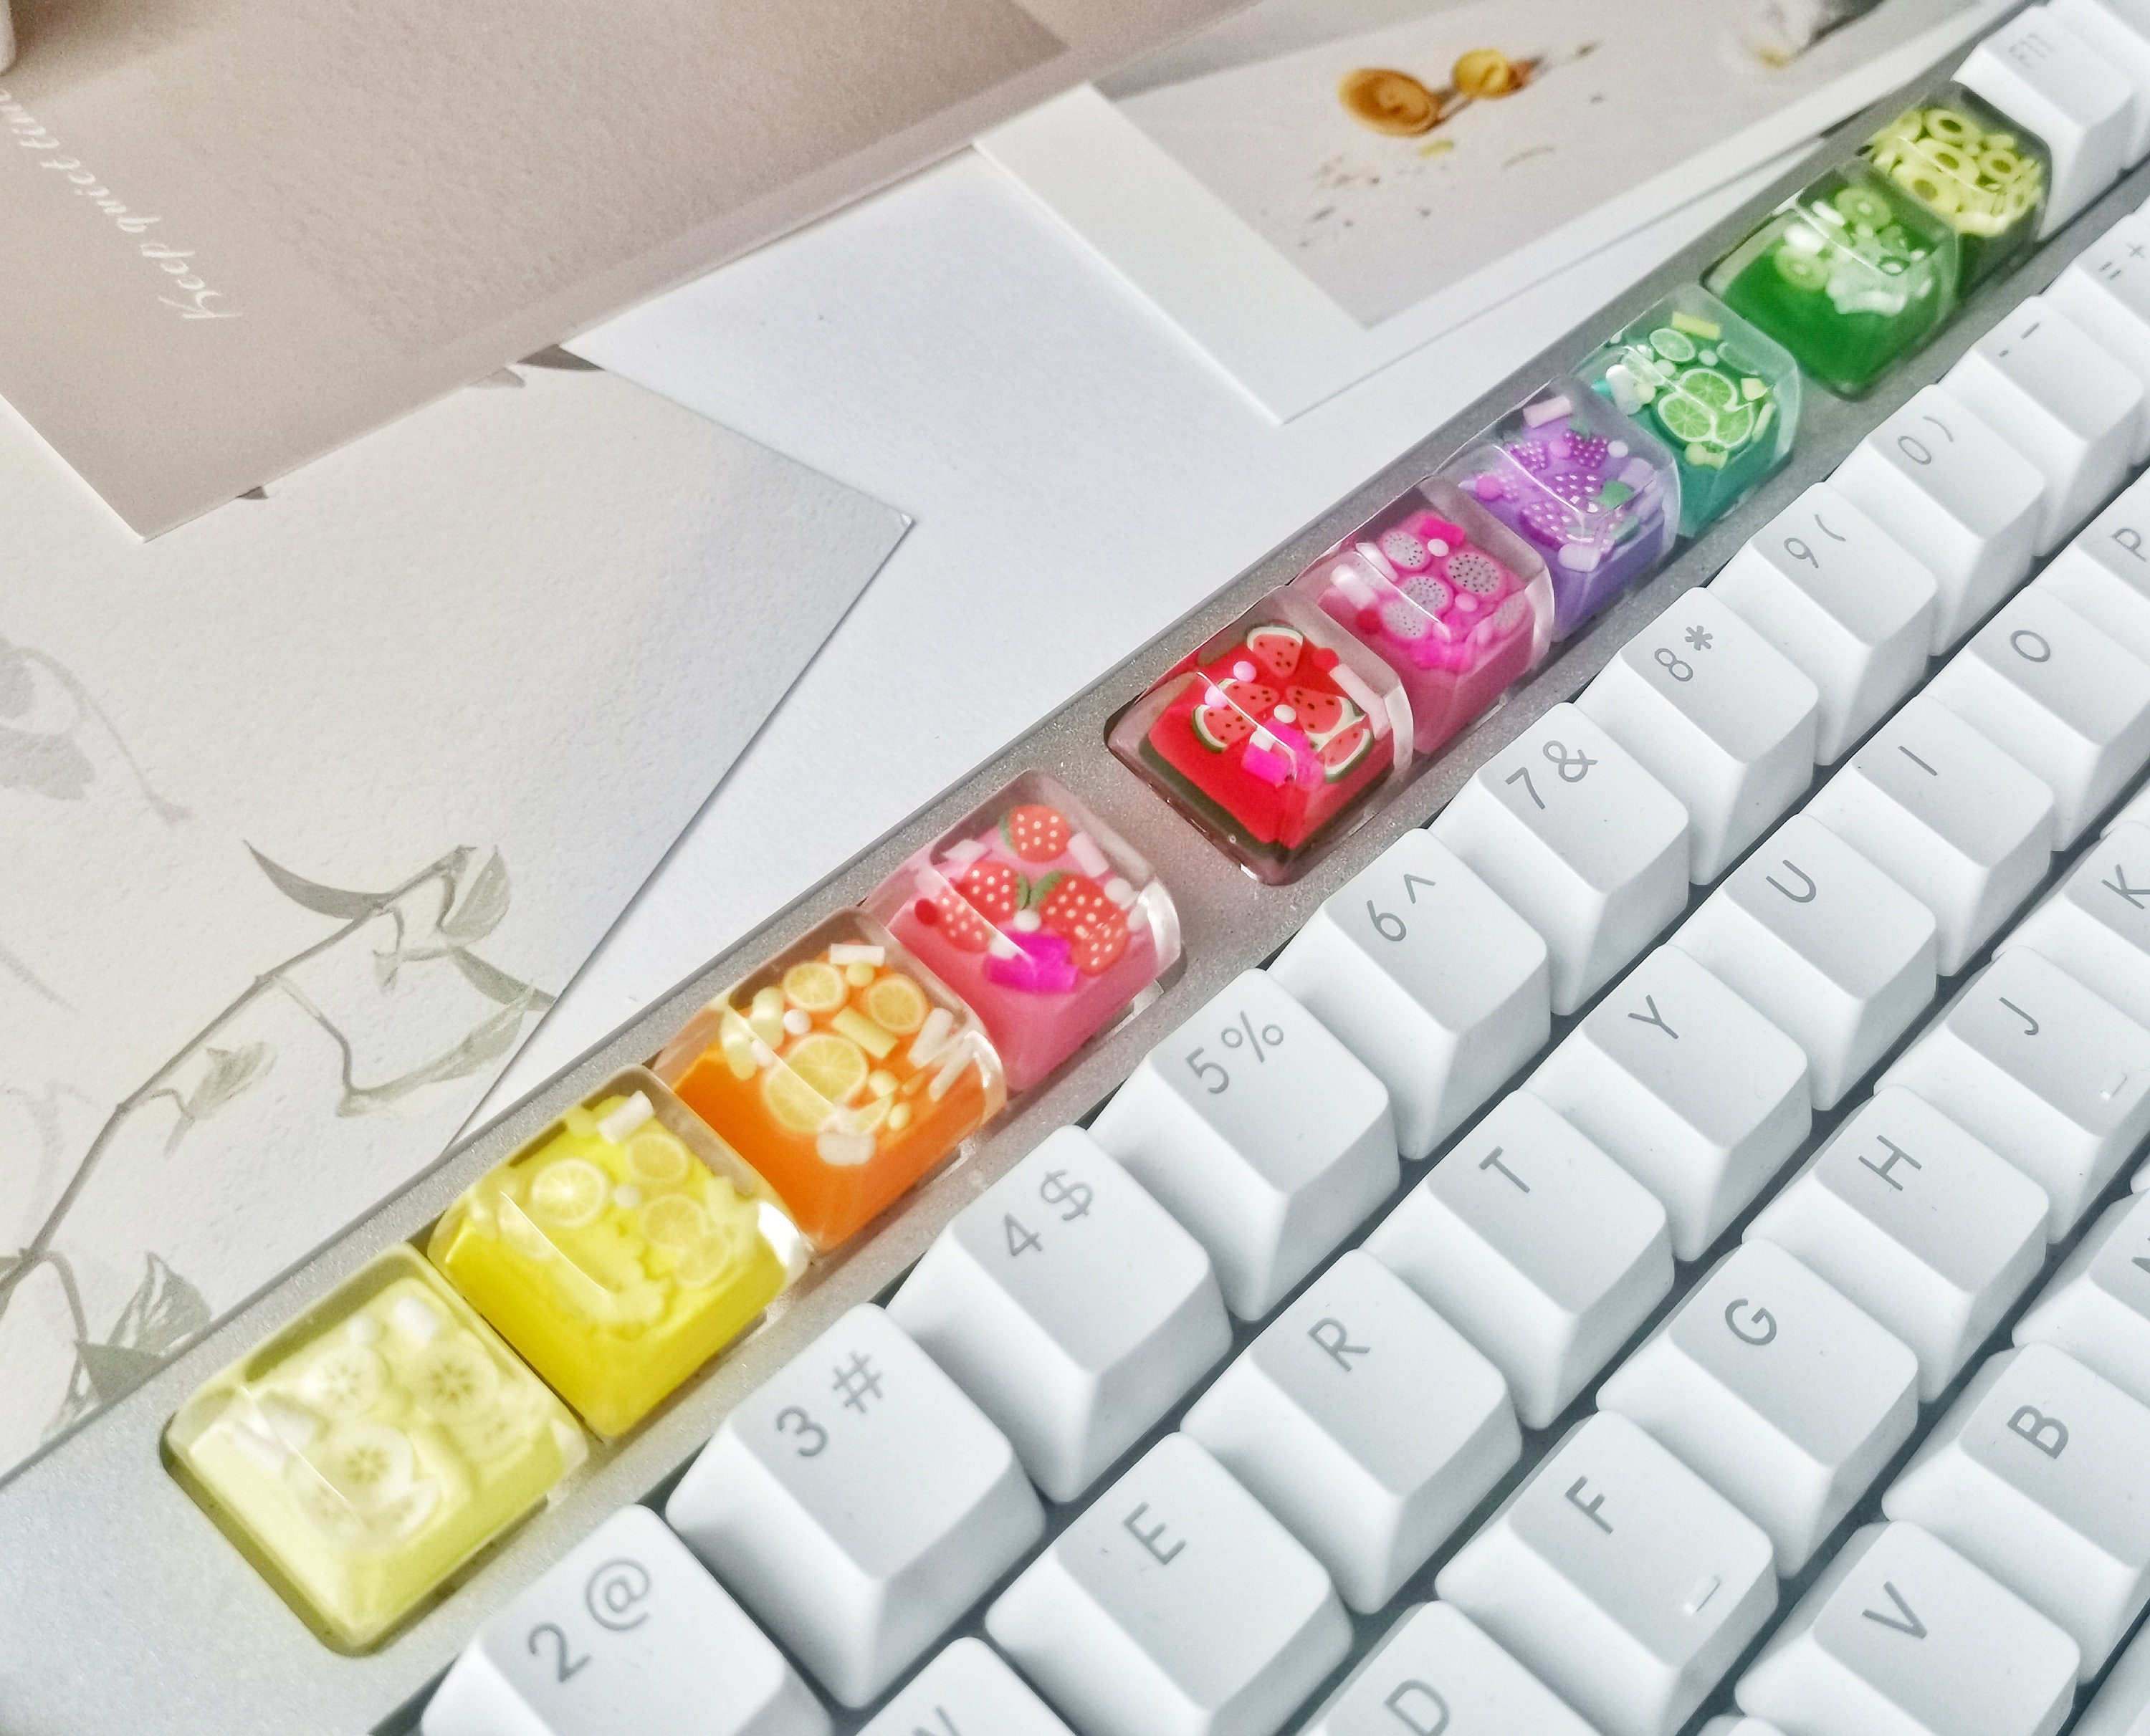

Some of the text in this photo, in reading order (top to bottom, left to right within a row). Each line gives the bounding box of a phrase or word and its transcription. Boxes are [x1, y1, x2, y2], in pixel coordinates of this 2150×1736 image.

[40, 157, 161, 233] quiet
[140, 242, 242, 320] Keep
[2111, 527, 2146, 562] P
[2010, 630, 2051, 663] O
[1766, 860, 1816, 903] U
[2102, 864, 2150, 909] K
[1628, 995, 1678, 1040] Y
[1999, 997, 2039, 1036] J
[1478, 1146, 1530, 1194] T
[1858, 1135, 1922, 1191] H
[1307, 1318, 1370, 1372] R
[1725, 1299, 1777, 1346] G
[2007, 1406, 2068, 1459] B
[1564, 1476, 1613, 1535] F
[1122, 1502, 1186, 1566] E
[1862, 1581, 1927, 1639] V
[1384, 1679, 1450, 1736] D
